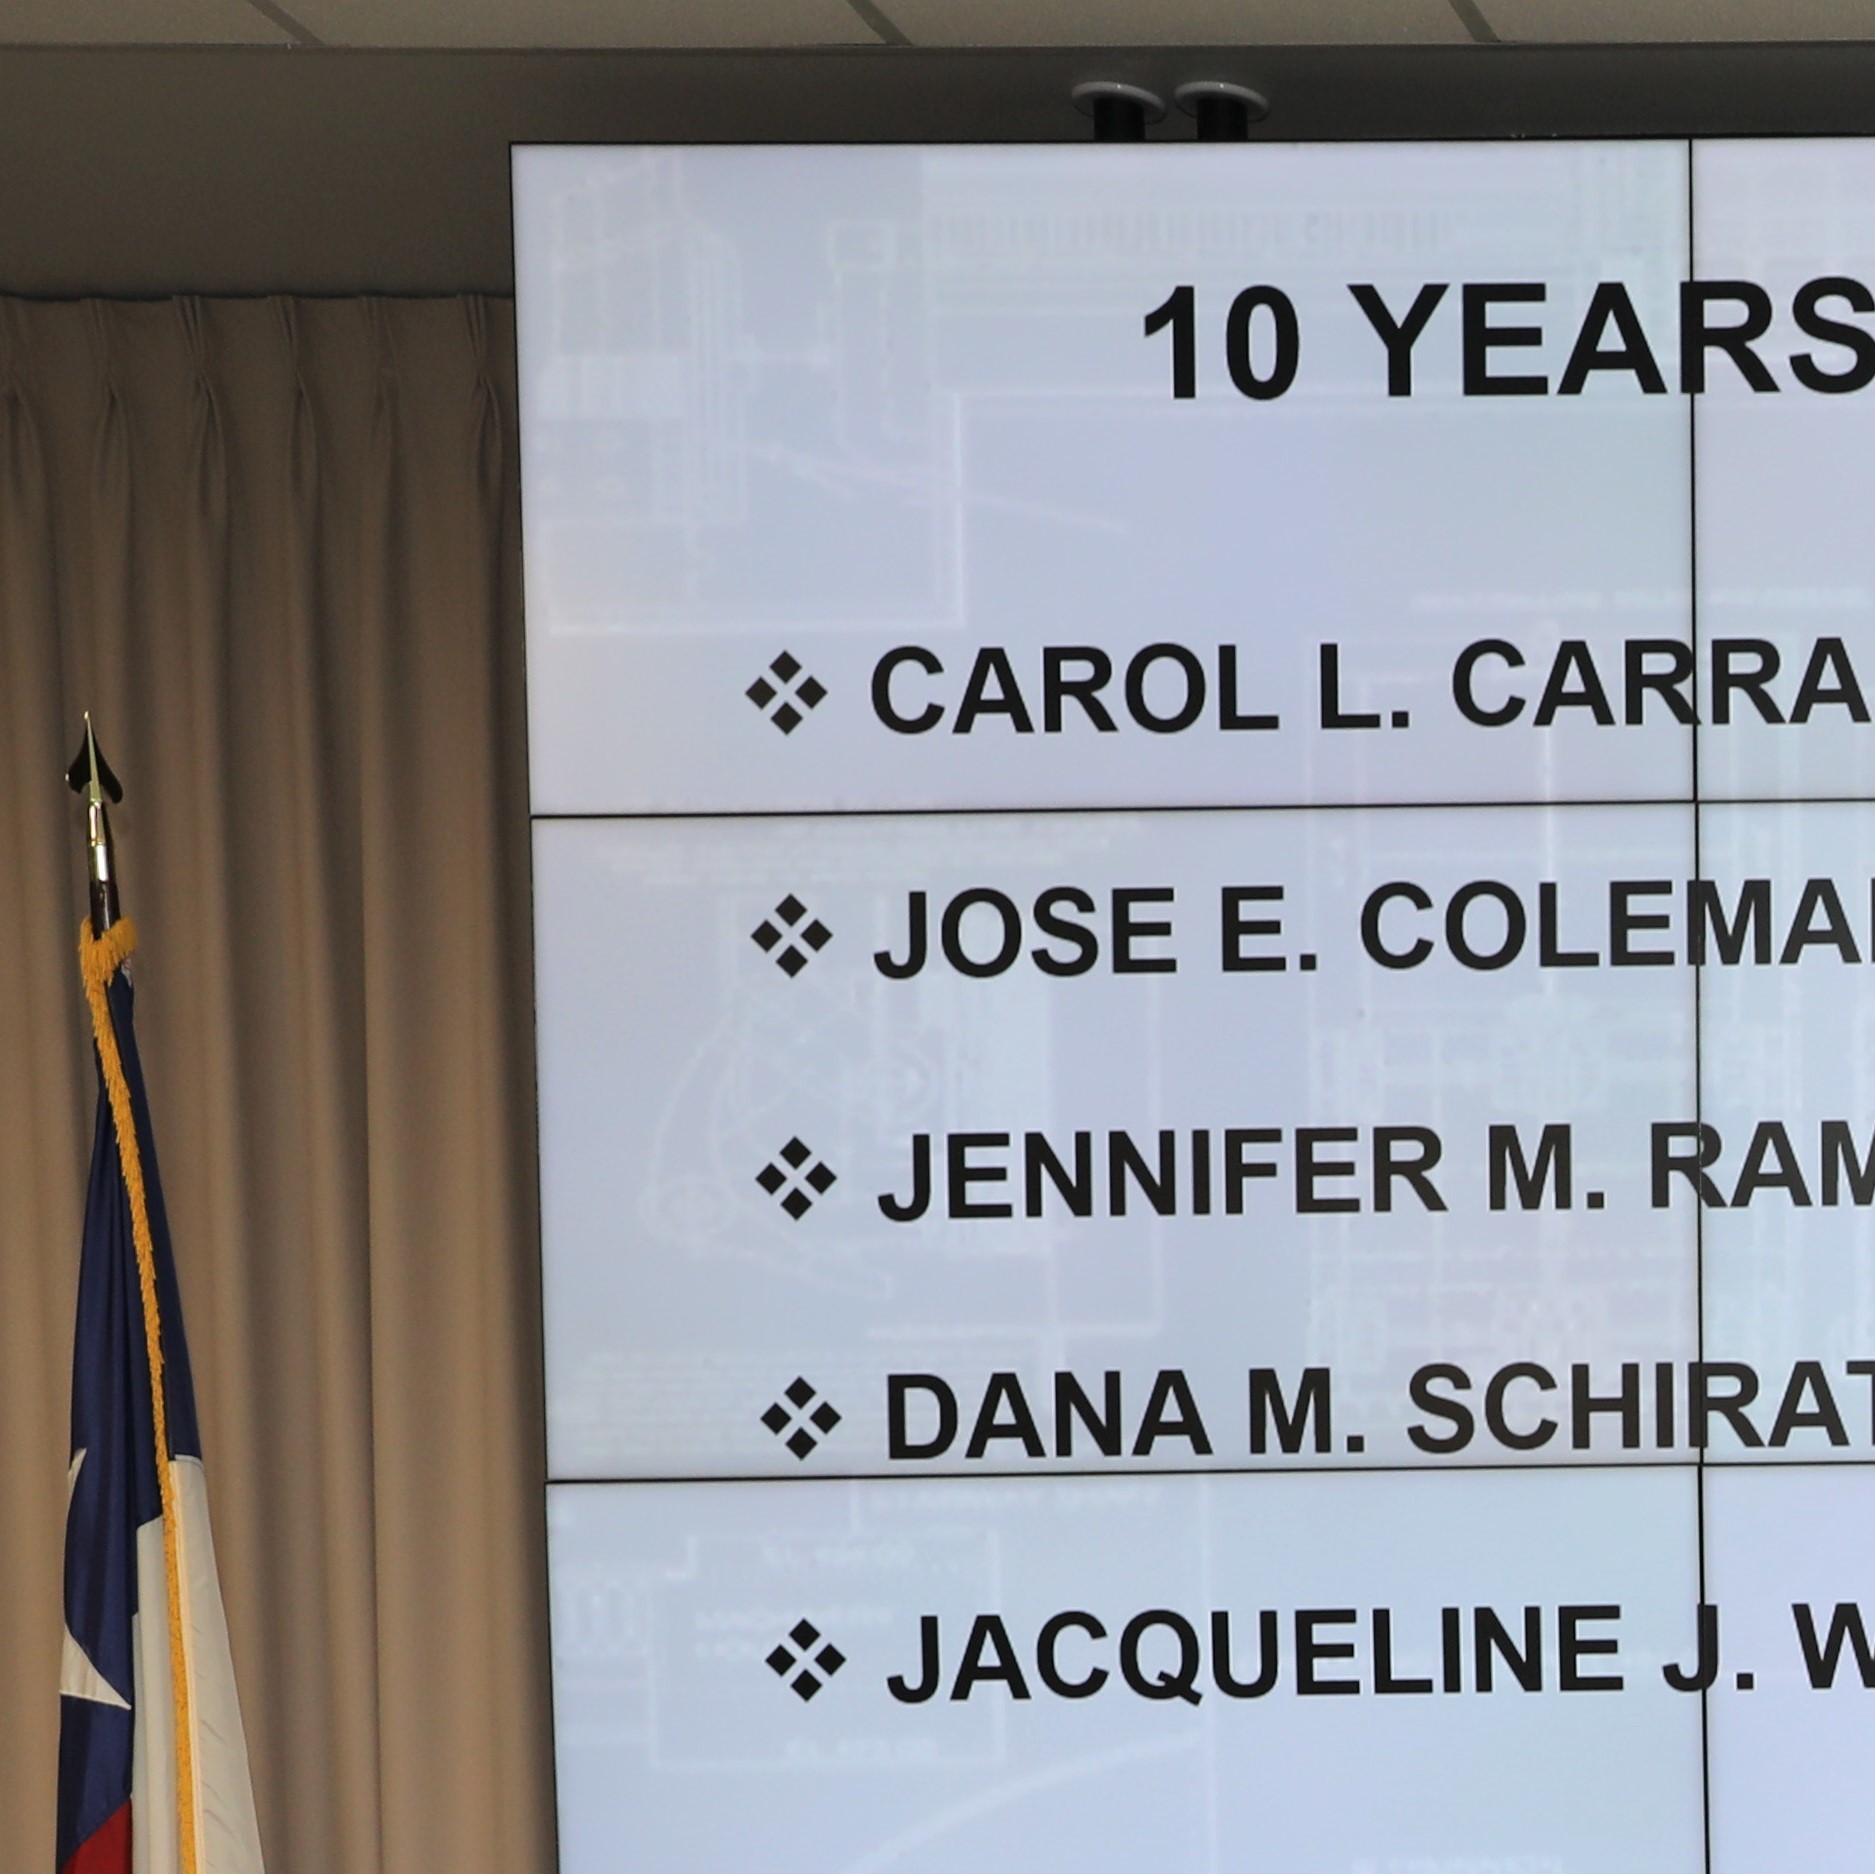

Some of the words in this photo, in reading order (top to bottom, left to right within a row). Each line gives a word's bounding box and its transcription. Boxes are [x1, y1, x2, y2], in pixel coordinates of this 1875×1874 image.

[1145, 284, 1299, 400] 10
[872, 643, 1279, 735] CAROL
[1321, 644, 1409, 729] L.
[873, 886, 1176, 979] JOSE
[1222, 885, 1317, 972] E.
[877, 1127, 1447, 1222] JENNIFER
[1489, 1123, 1605, 1210] M.
[887, 1368, 1213, 1459] DANA
[1249, 1367, 1364, 1455] M.
[886, 1607, 1623, 1705] JACQUELINE
[1662, 1603, 1753, 1693] J.
